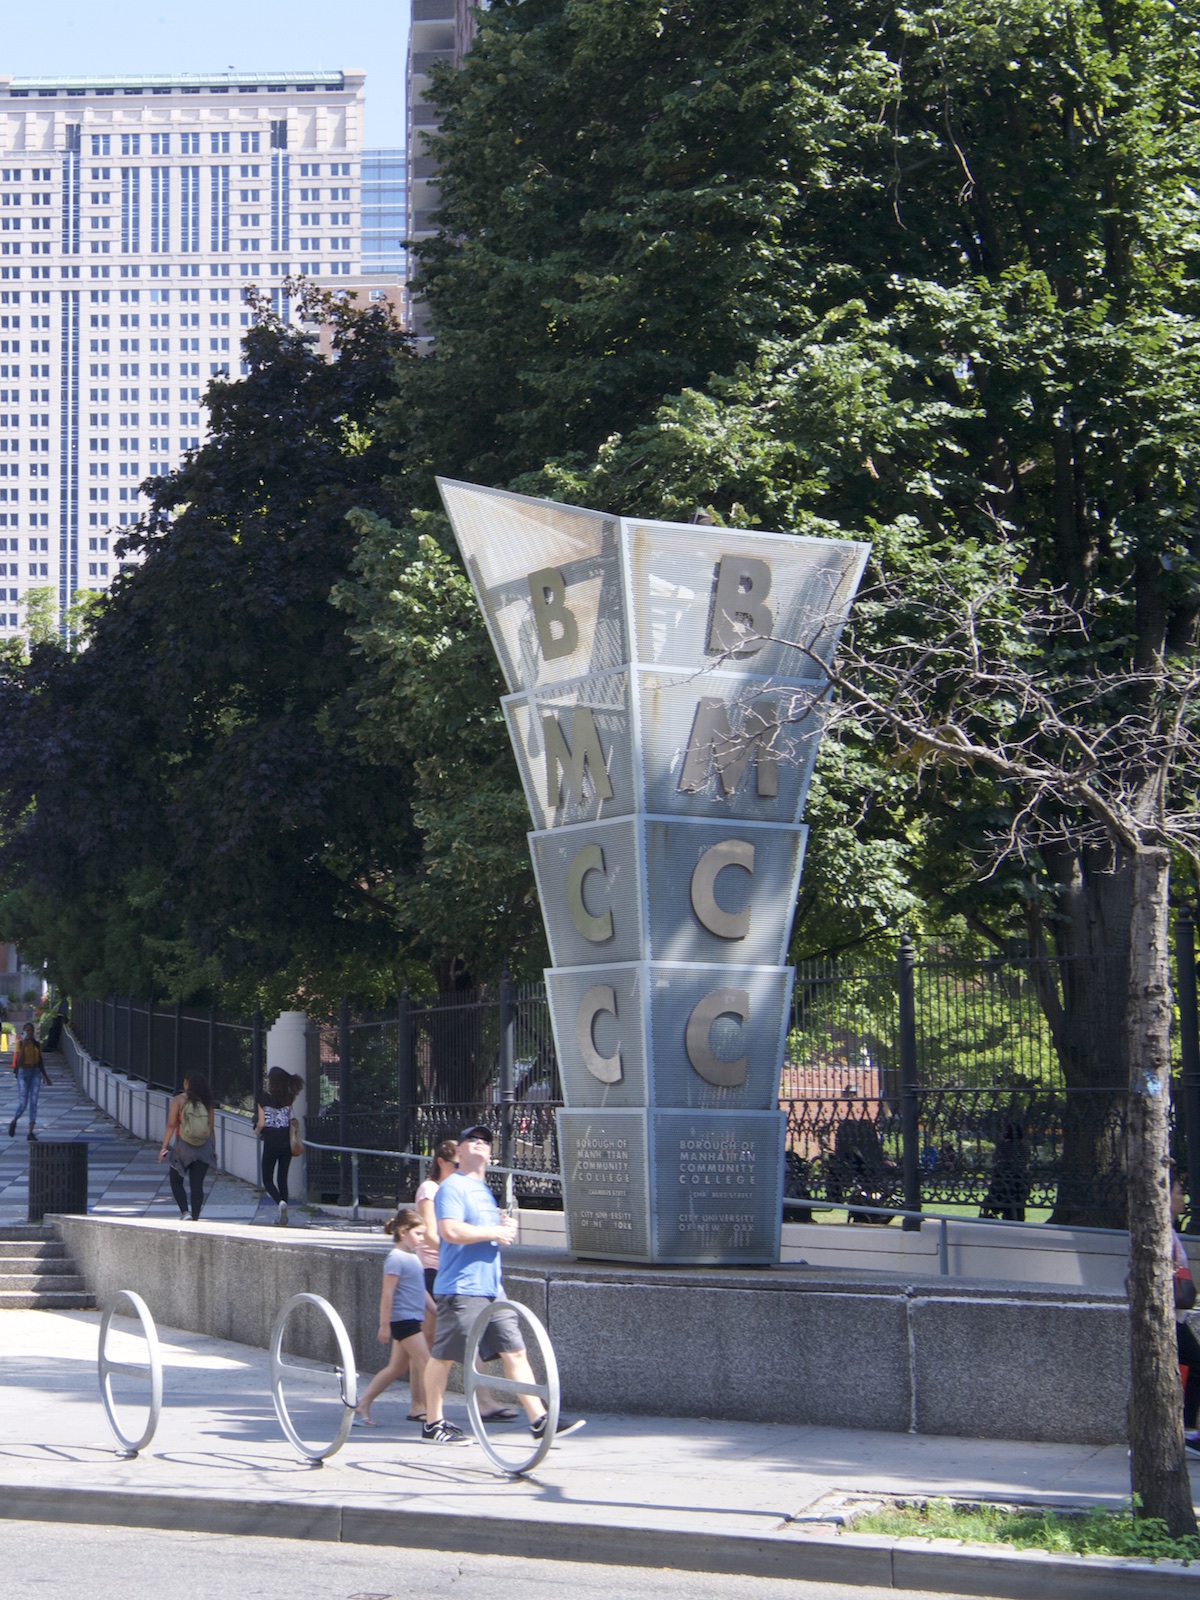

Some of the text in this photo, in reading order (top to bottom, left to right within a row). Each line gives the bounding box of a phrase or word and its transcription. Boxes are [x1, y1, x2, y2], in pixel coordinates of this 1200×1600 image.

[576, 1138, 628, 1149] BOROUGH OF
[680, 1140, 756, 1150] BOROUGH OF
[577, 1150, 629, 1160] MANHTTAN
[680, 1151, 756, 1162] MANHATTAN
[577, 1160, 629, 1171] COMMUNITY
[680, 1163, 756, 1173] COMMUNITY
[578, 1172, 630, 1183] COLLEGE
[679, 1174, 756, 1185] COLLEGE
[580, 1210, 632, 1220] CITY UNIERSITY
[679, 1213, 755, 1223] CITY UNIVERSITY
[697, 1223, 720, 1232] NEW
